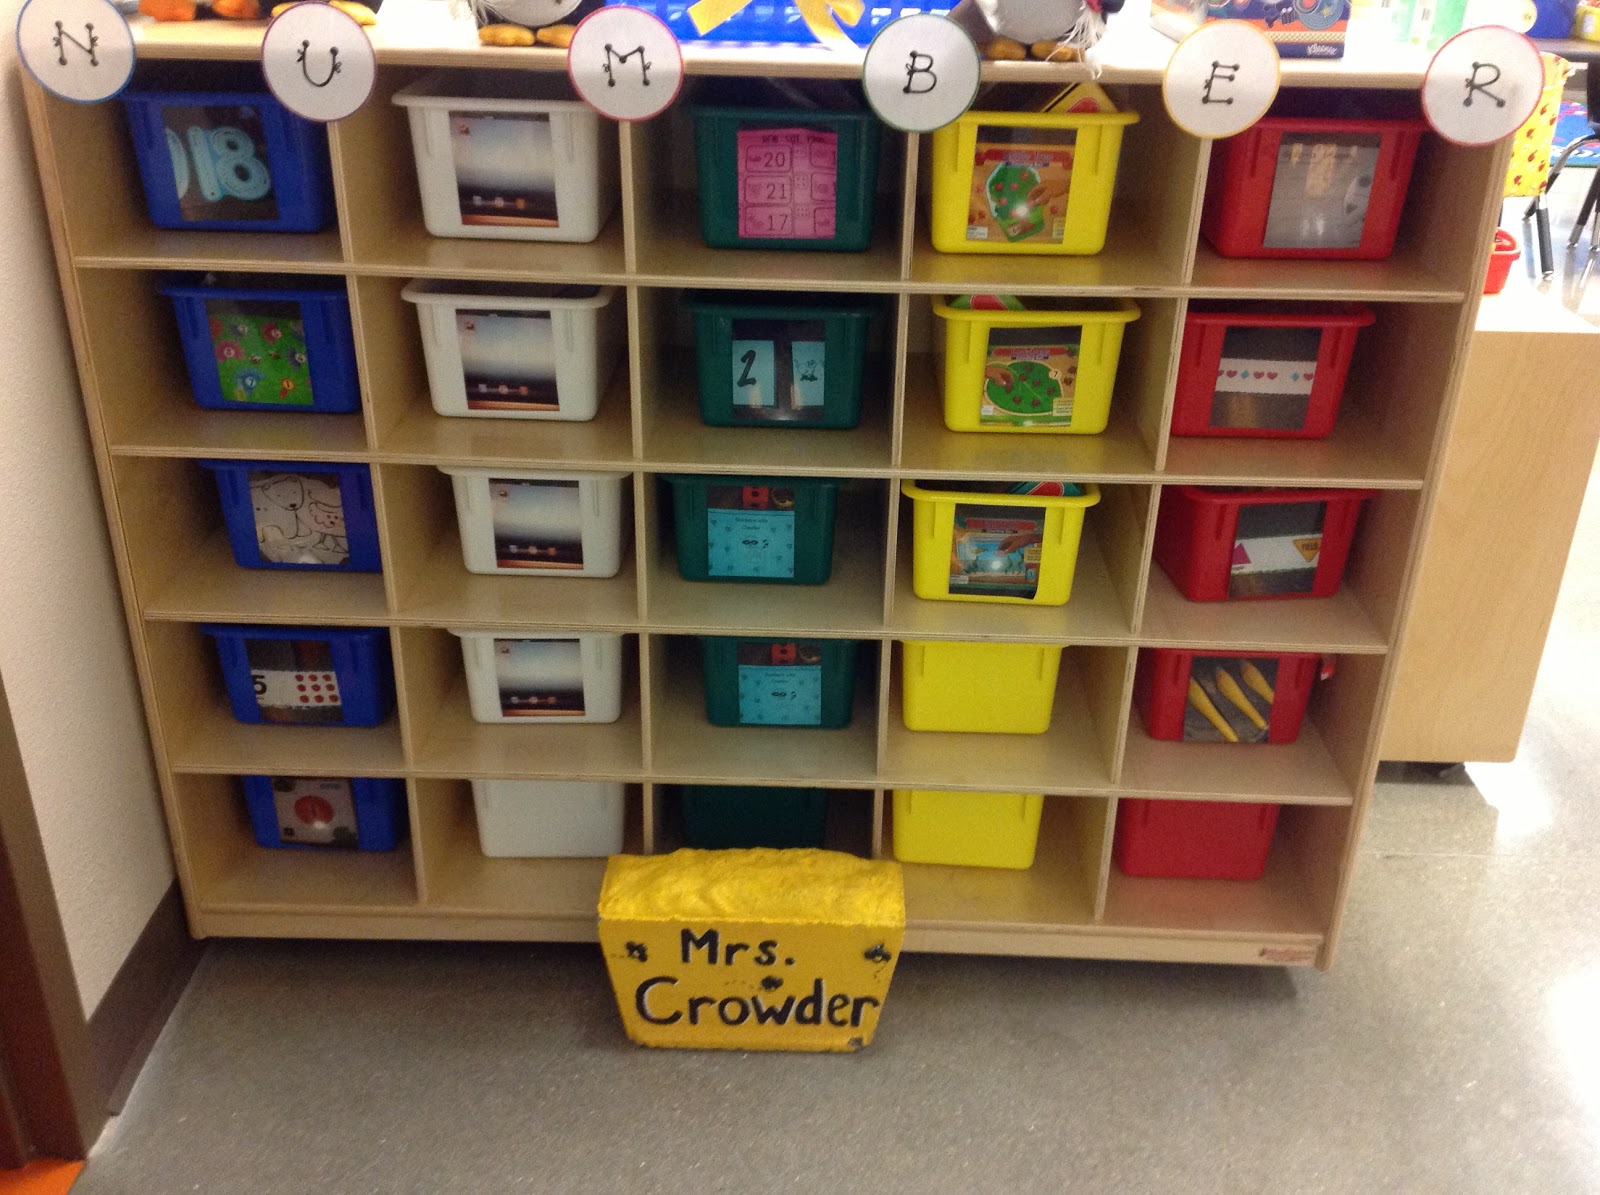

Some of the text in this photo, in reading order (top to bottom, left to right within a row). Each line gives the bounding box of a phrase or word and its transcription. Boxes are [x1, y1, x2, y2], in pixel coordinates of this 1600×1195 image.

[53, 20, 99, 67] N
[297, 39, 342, 88] U
[602, 43, 652, 88] M
[903, 50, 938, 94] B
[1202, 60, 1240, 105] E
[1463, 61, 1506, 108] R
[764, 152, 786, 168] 20
[766, 183, 788, 200] 21
[767, 214, 789, 231] 17
[737, 349, 757, 388] 2
[680, 927, 796, 966] Mrs.
[635, 975, 881, 1028] Crowder
